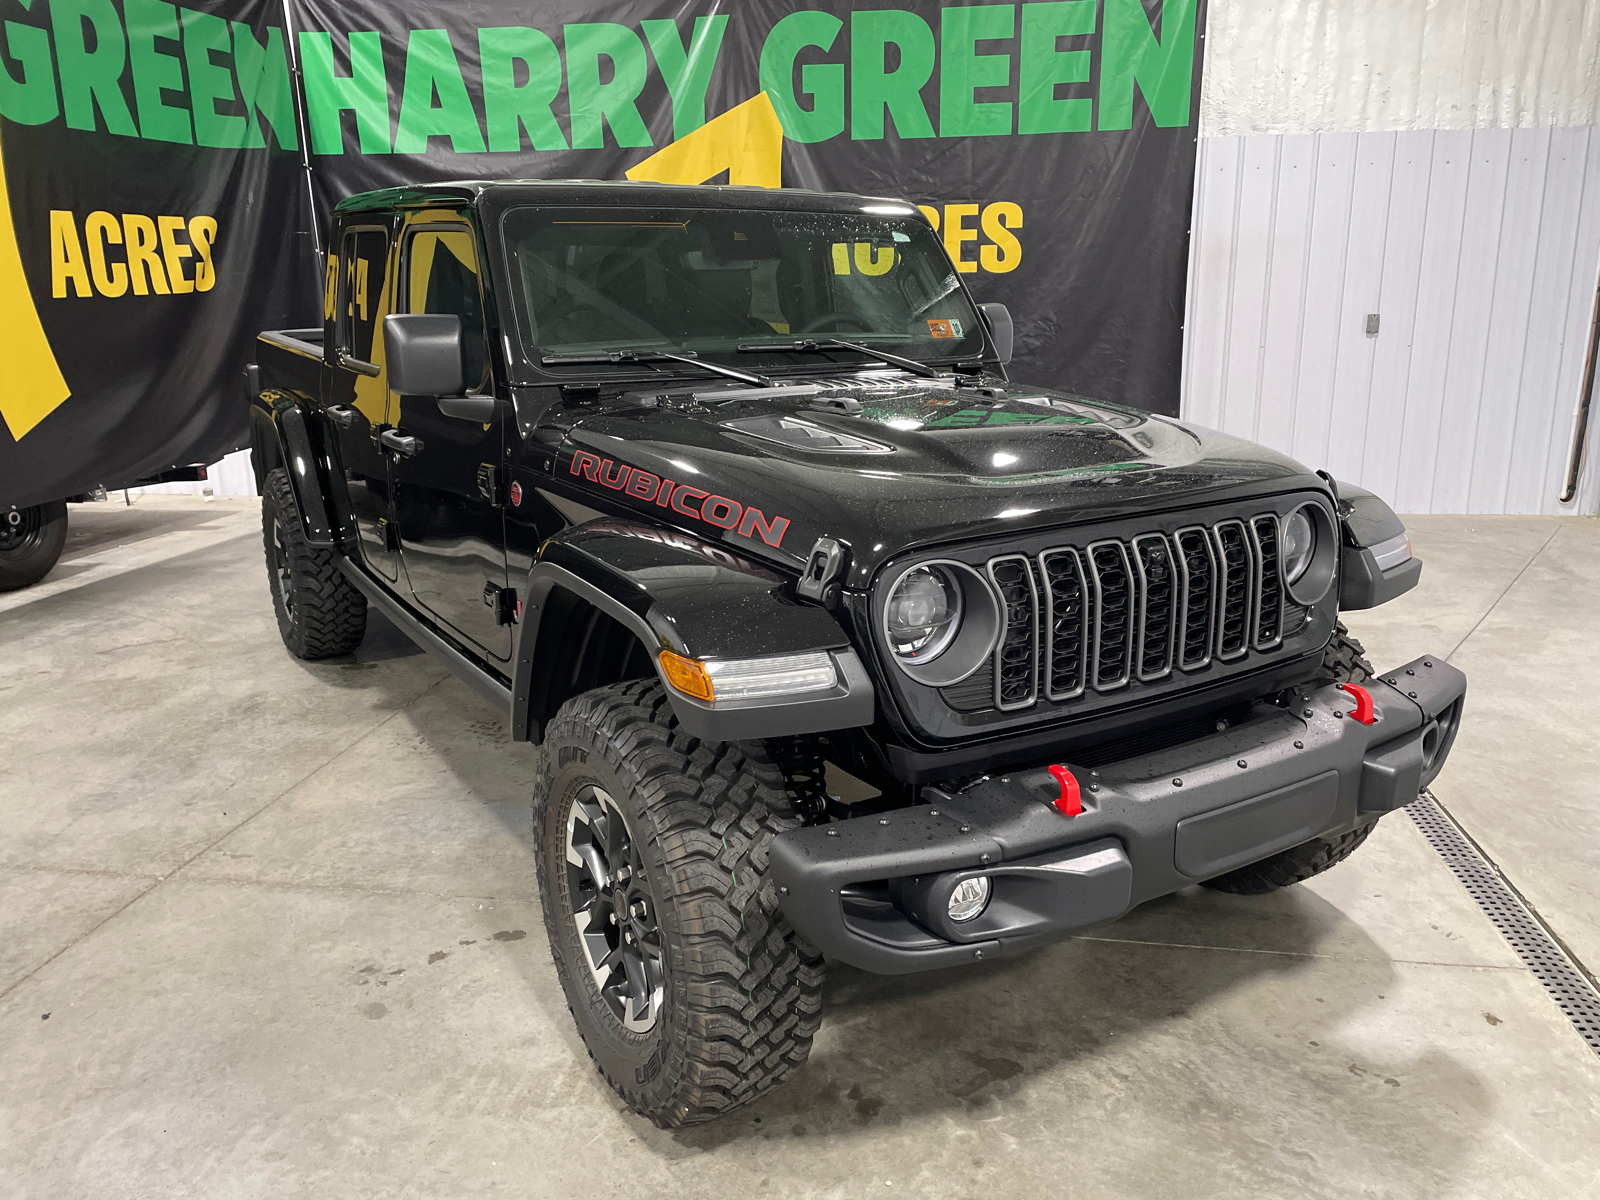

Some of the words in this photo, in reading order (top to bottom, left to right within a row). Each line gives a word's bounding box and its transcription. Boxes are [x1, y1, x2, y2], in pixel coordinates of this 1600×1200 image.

[0, 0, 299, 152] GREEN
[298, 14, 729, 156] HARRY
[759, 0, 1198, 144] GREEN
[51, 208, 218, 299] ACRES
[569, 449, 791, 549] RUBICON
